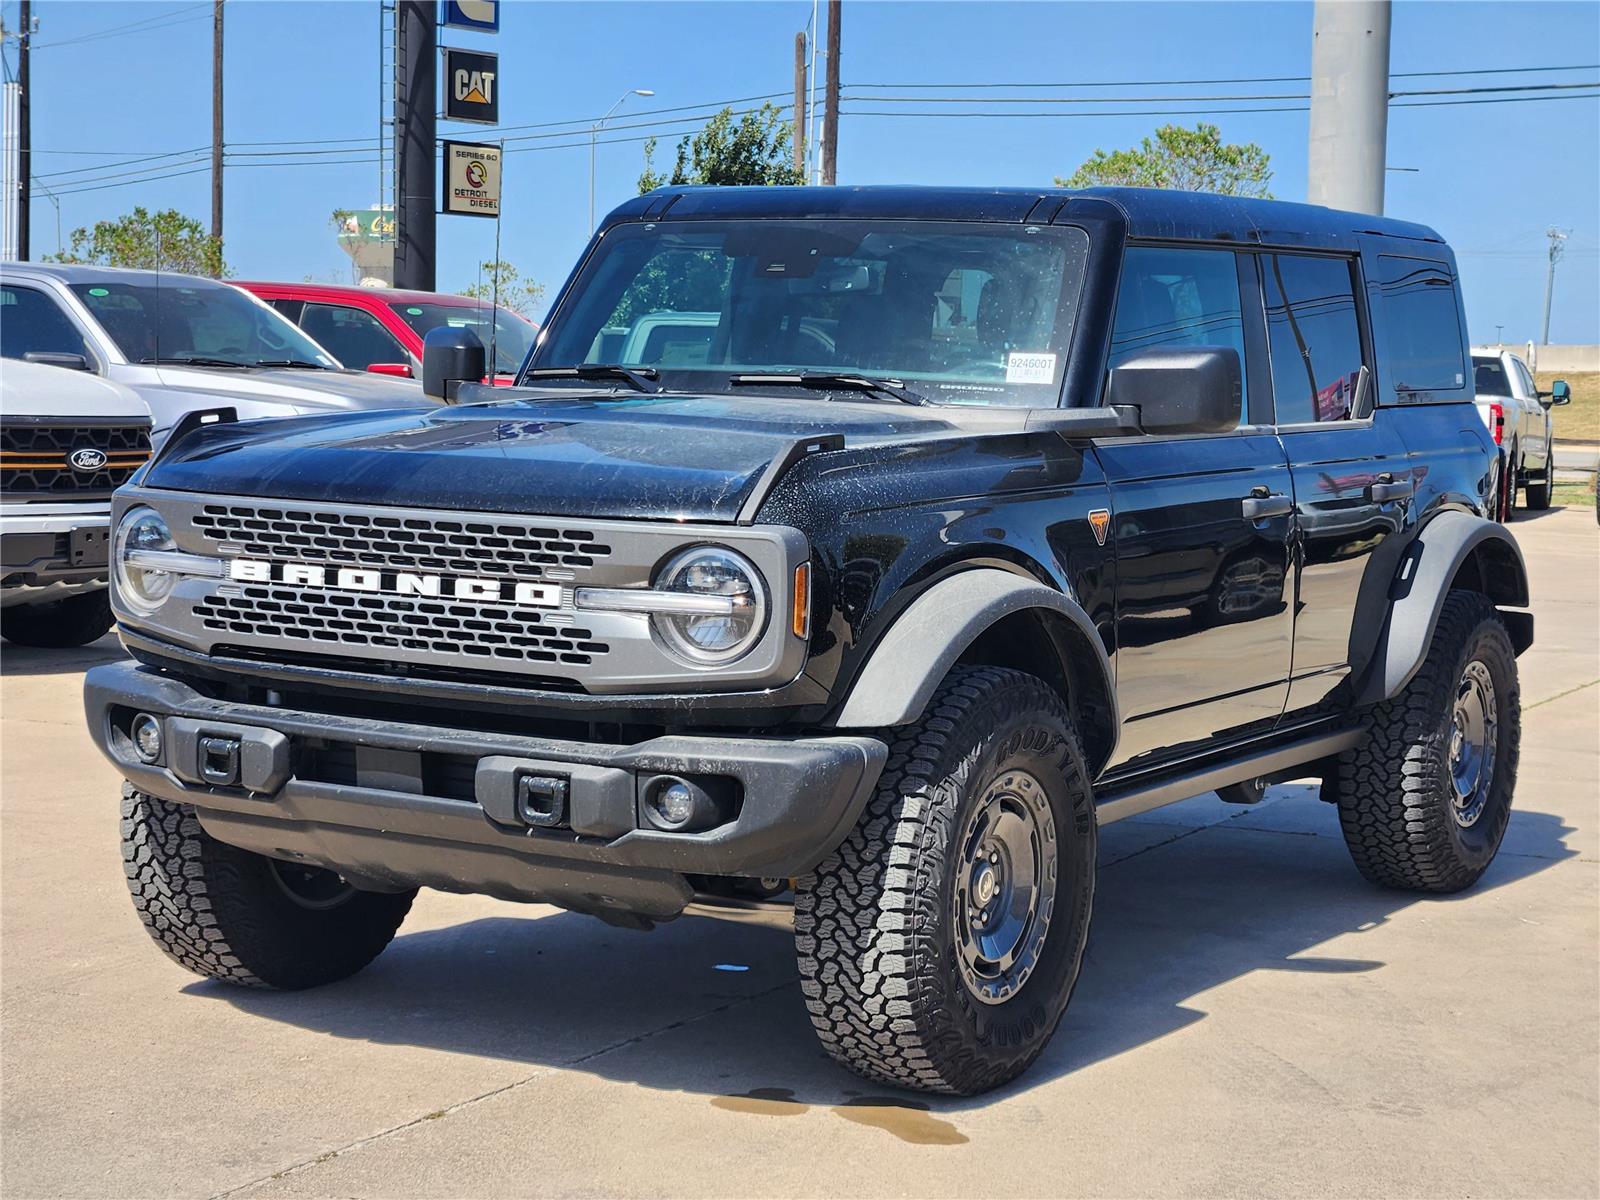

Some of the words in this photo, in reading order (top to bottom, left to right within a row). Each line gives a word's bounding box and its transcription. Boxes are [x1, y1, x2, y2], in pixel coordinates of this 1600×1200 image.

[455, 68, 495, 104] CAT
[455, 150, 485, 160] SERIES
[486, 154, 498, 162] 60
[454, 188, 488, 198] DETROIT
[470, 199, 498, 209] DIESEL
[78, 451, 101, 466] Ford
[230, 559, 562, 606] BRONCO
